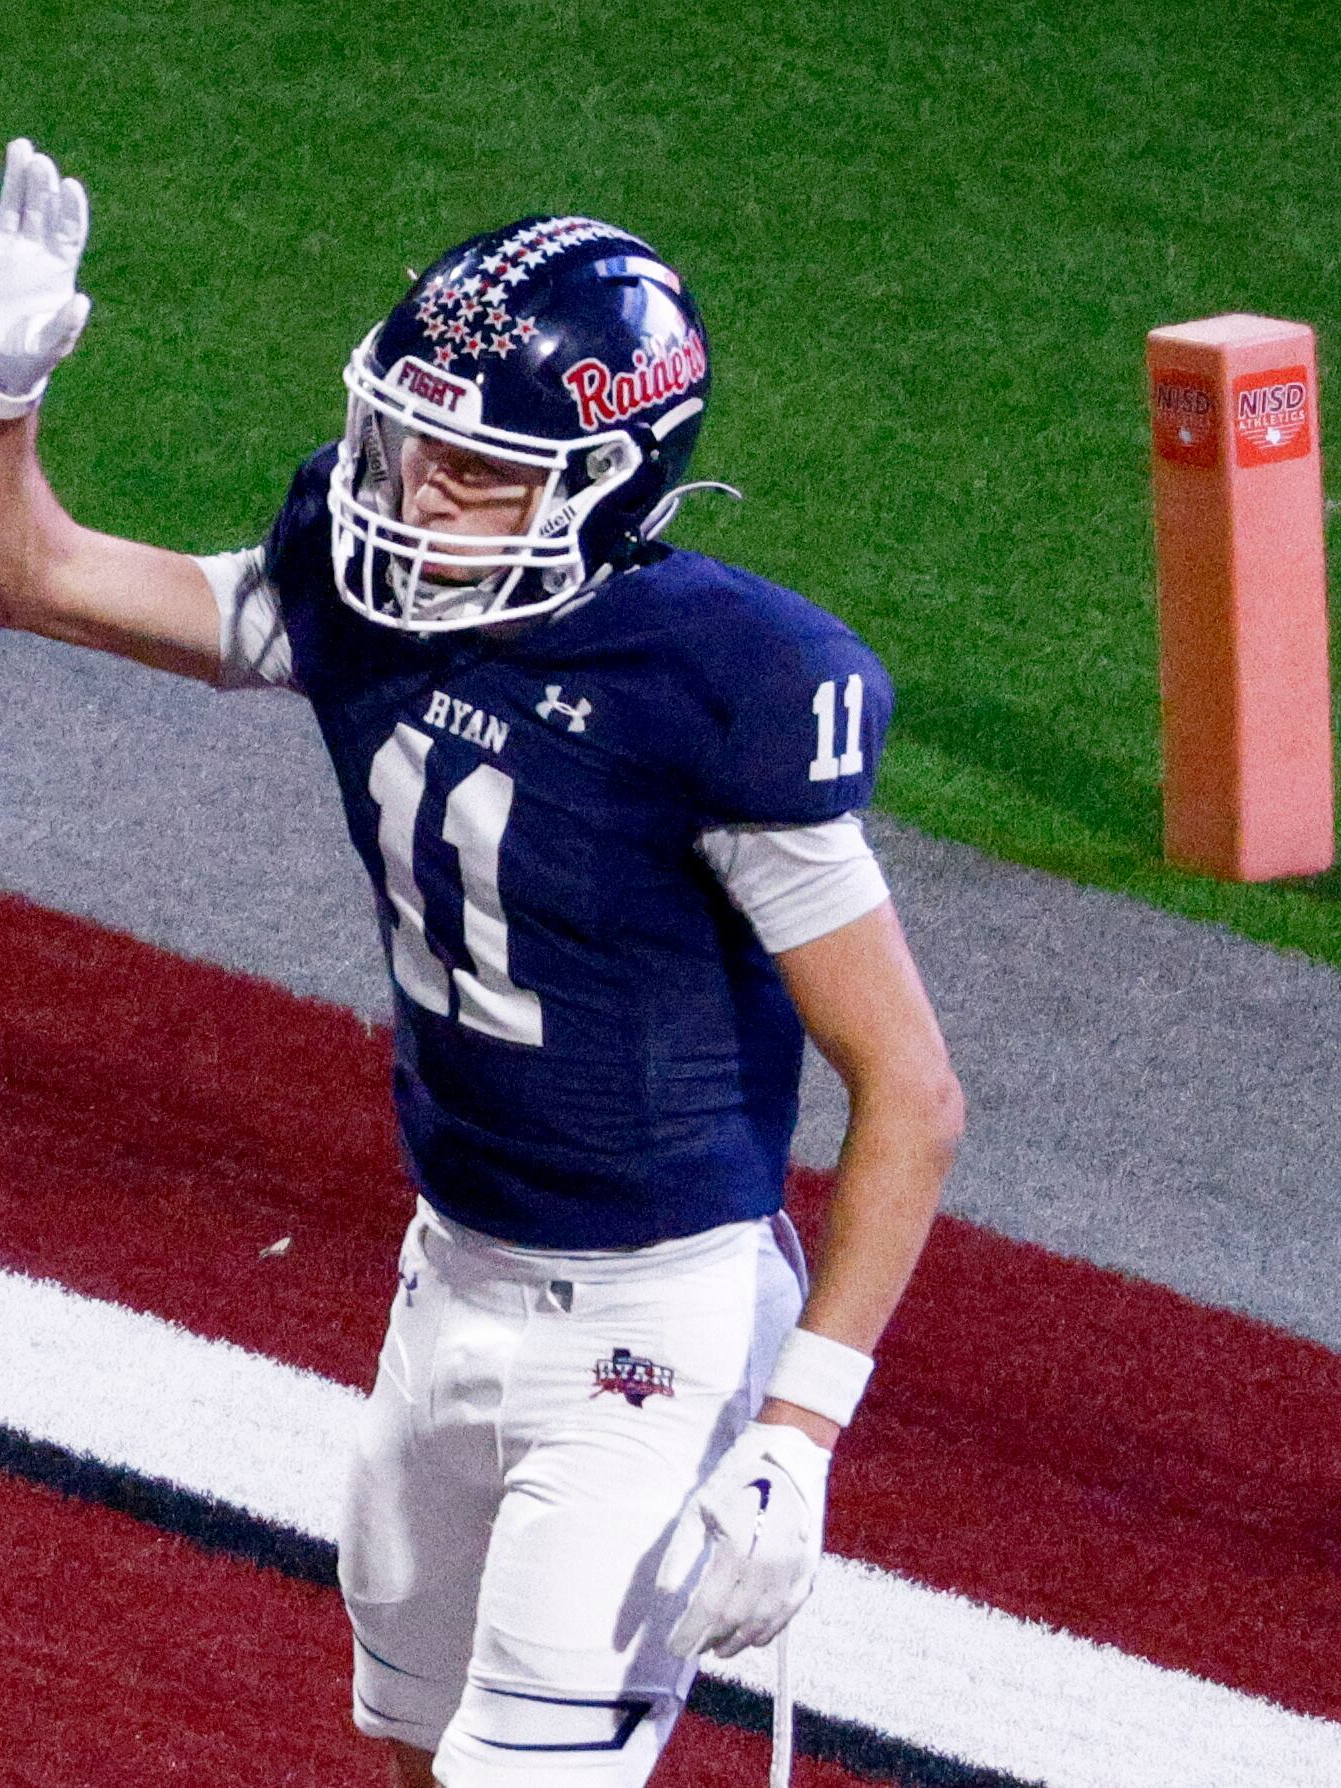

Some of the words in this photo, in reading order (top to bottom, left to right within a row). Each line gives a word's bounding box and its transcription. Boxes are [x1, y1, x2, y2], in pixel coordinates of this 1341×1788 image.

[398, 361, 466, 412] FIGHT
[562, 328, 706, 432] Raiders
[1238, 382, 1307, 420] NISD
[1239, 410, 1306, 431] ATHLETICS
[539, 505, 577, 537] dell
[423, 690, 510, 754] RYAN
[809, 673, 863, 782] 11
[368, 721, 544, 1048] 11
